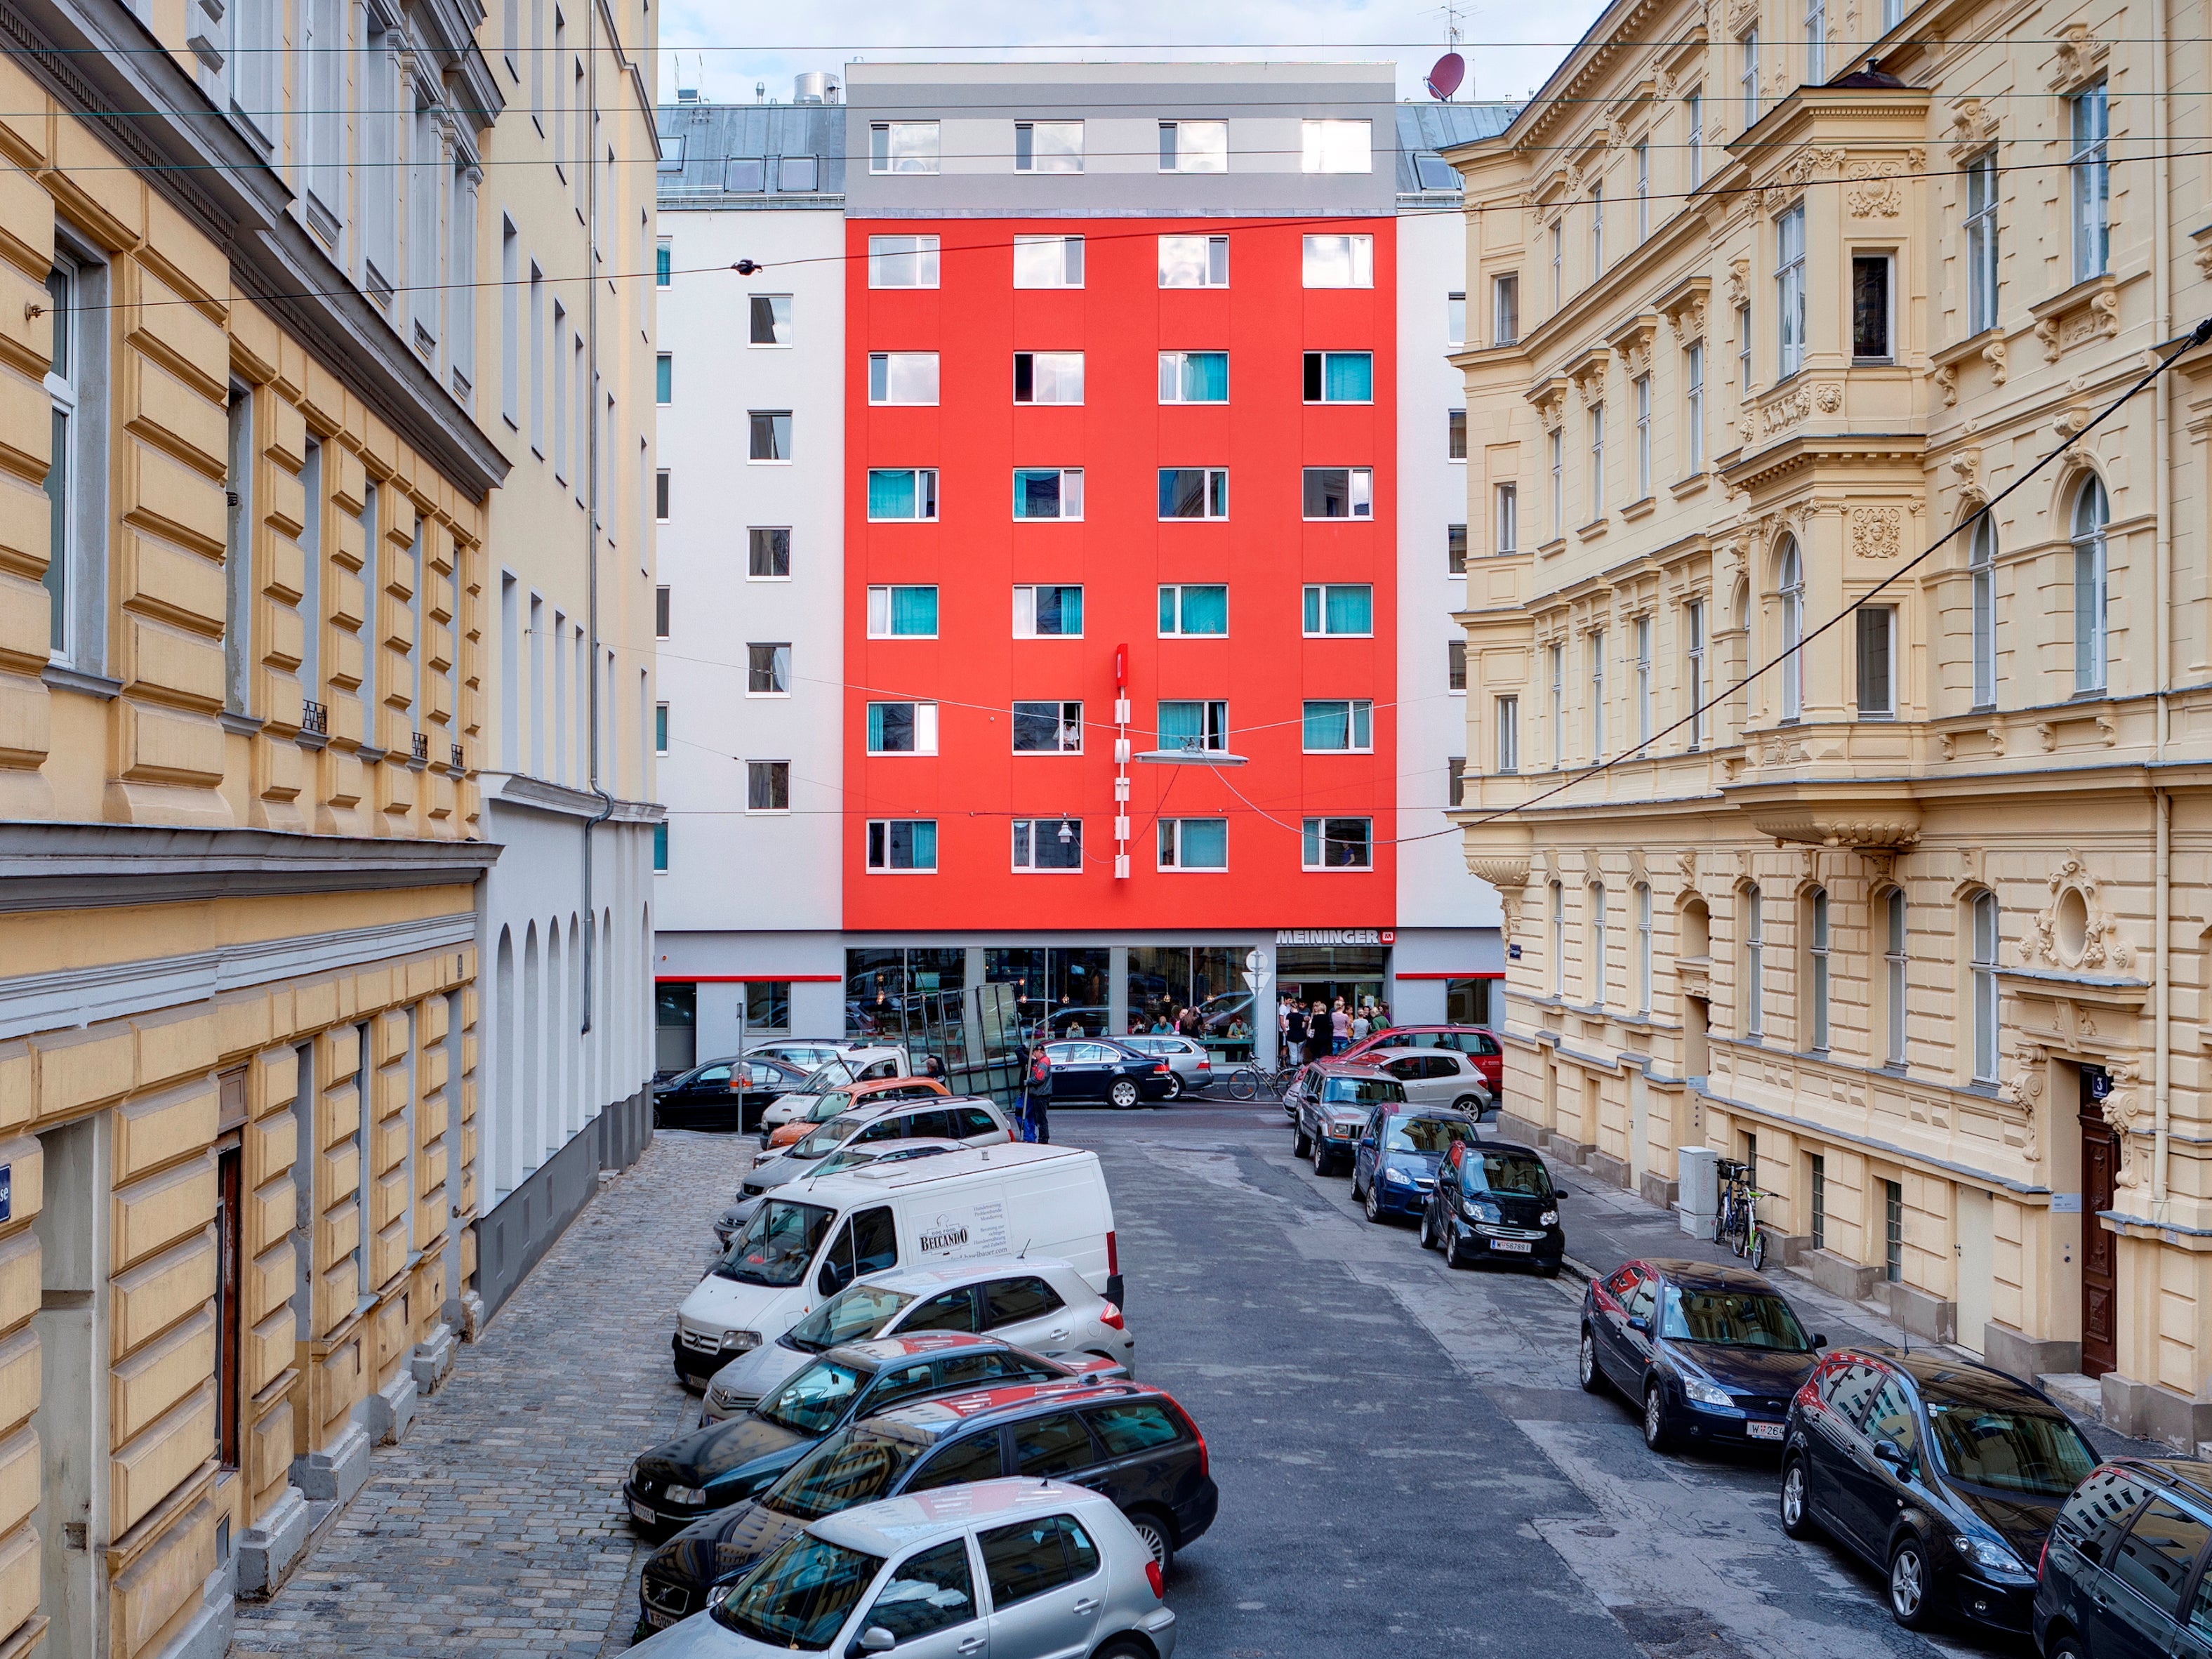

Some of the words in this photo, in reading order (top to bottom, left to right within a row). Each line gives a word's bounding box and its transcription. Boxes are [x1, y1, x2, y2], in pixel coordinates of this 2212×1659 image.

[1276, 930, 1378, 944] MEININGER
[2097, 1076, 2103, 1091] 3
[920, 1228, 967, 1251] BELCANDO
[1752, 1424, 1760, 1434] W
